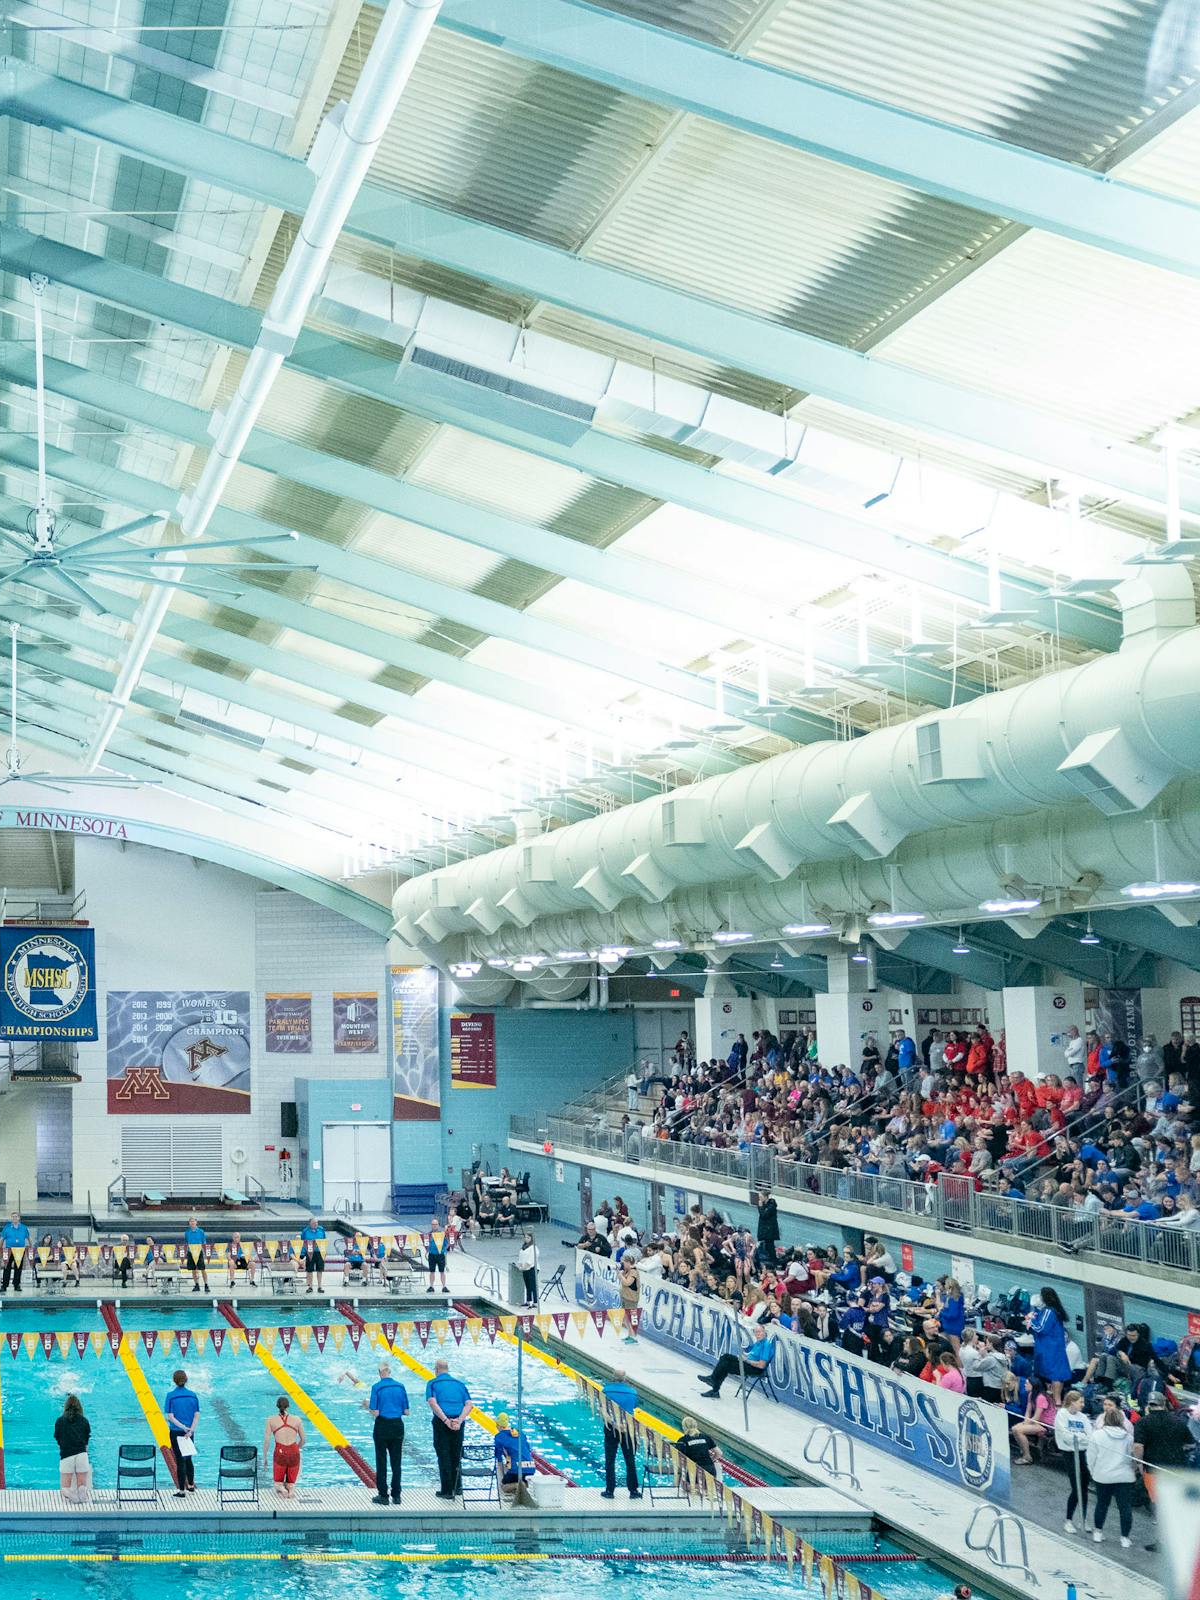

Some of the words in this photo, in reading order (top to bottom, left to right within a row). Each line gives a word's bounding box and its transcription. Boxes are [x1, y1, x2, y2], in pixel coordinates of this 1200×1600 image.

[15, 811, 129, 839] MINNESOTA
[18, 937, 77, 957] MINNESOTA
[24, 968, 72, 989] MSHSL
[16, 1000, 37, 1017] HIGH
[38, 1006, 72, 1019] SCHOOL
[132, 1001, 148, 1009] 2012
[181, 999, 228, 1008] WOMEN'S
[0, 1025, 94, 1037] CHAMPIONSHIPS
[186, 1028, 245, 1036] CHAMPIONS
[653, 1288, 957, 1468] CHAMPONSHIPS
